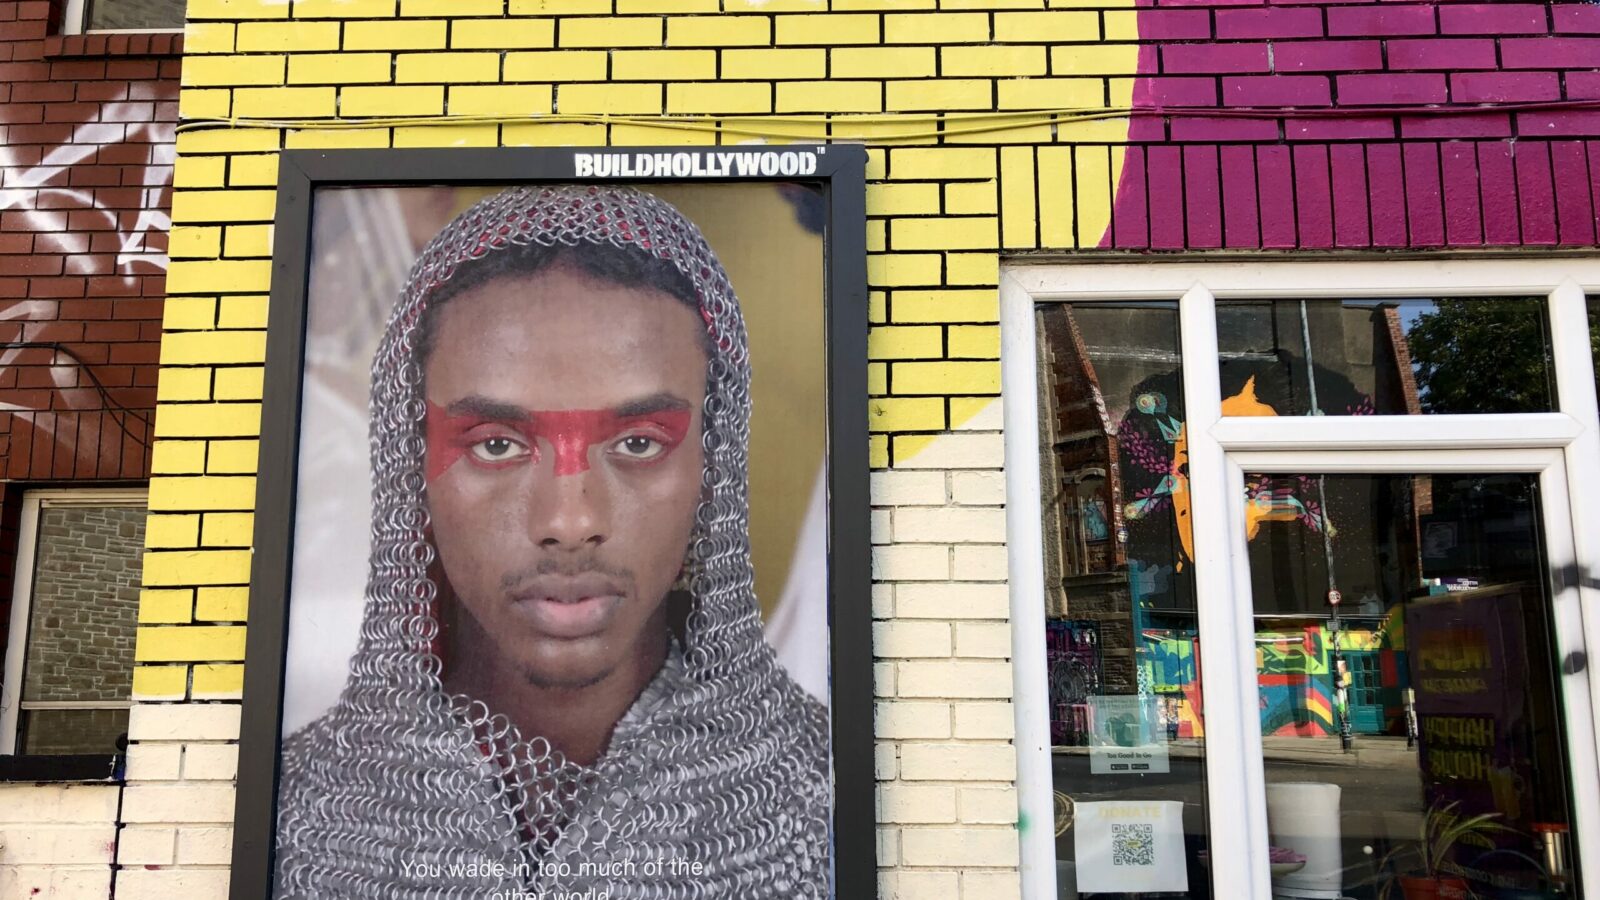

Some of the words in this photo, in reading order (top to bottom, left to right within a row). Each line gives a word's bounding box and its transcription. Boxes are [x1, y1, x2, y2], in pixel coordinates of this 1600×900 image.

[574, 152, 817, 177] BUILDHOLLYWOOD
[1098, 806, 1161, 818] DONATE
[400, 859, 441, 878] You
[448, 859, 506, 878] wade
[513, 859, 530, 877] in
[537, 860, 571, 877] too
[579, 858, 636, 877] much
[643, 857, 664, 876] of
[670, 857, 704, 876] the
